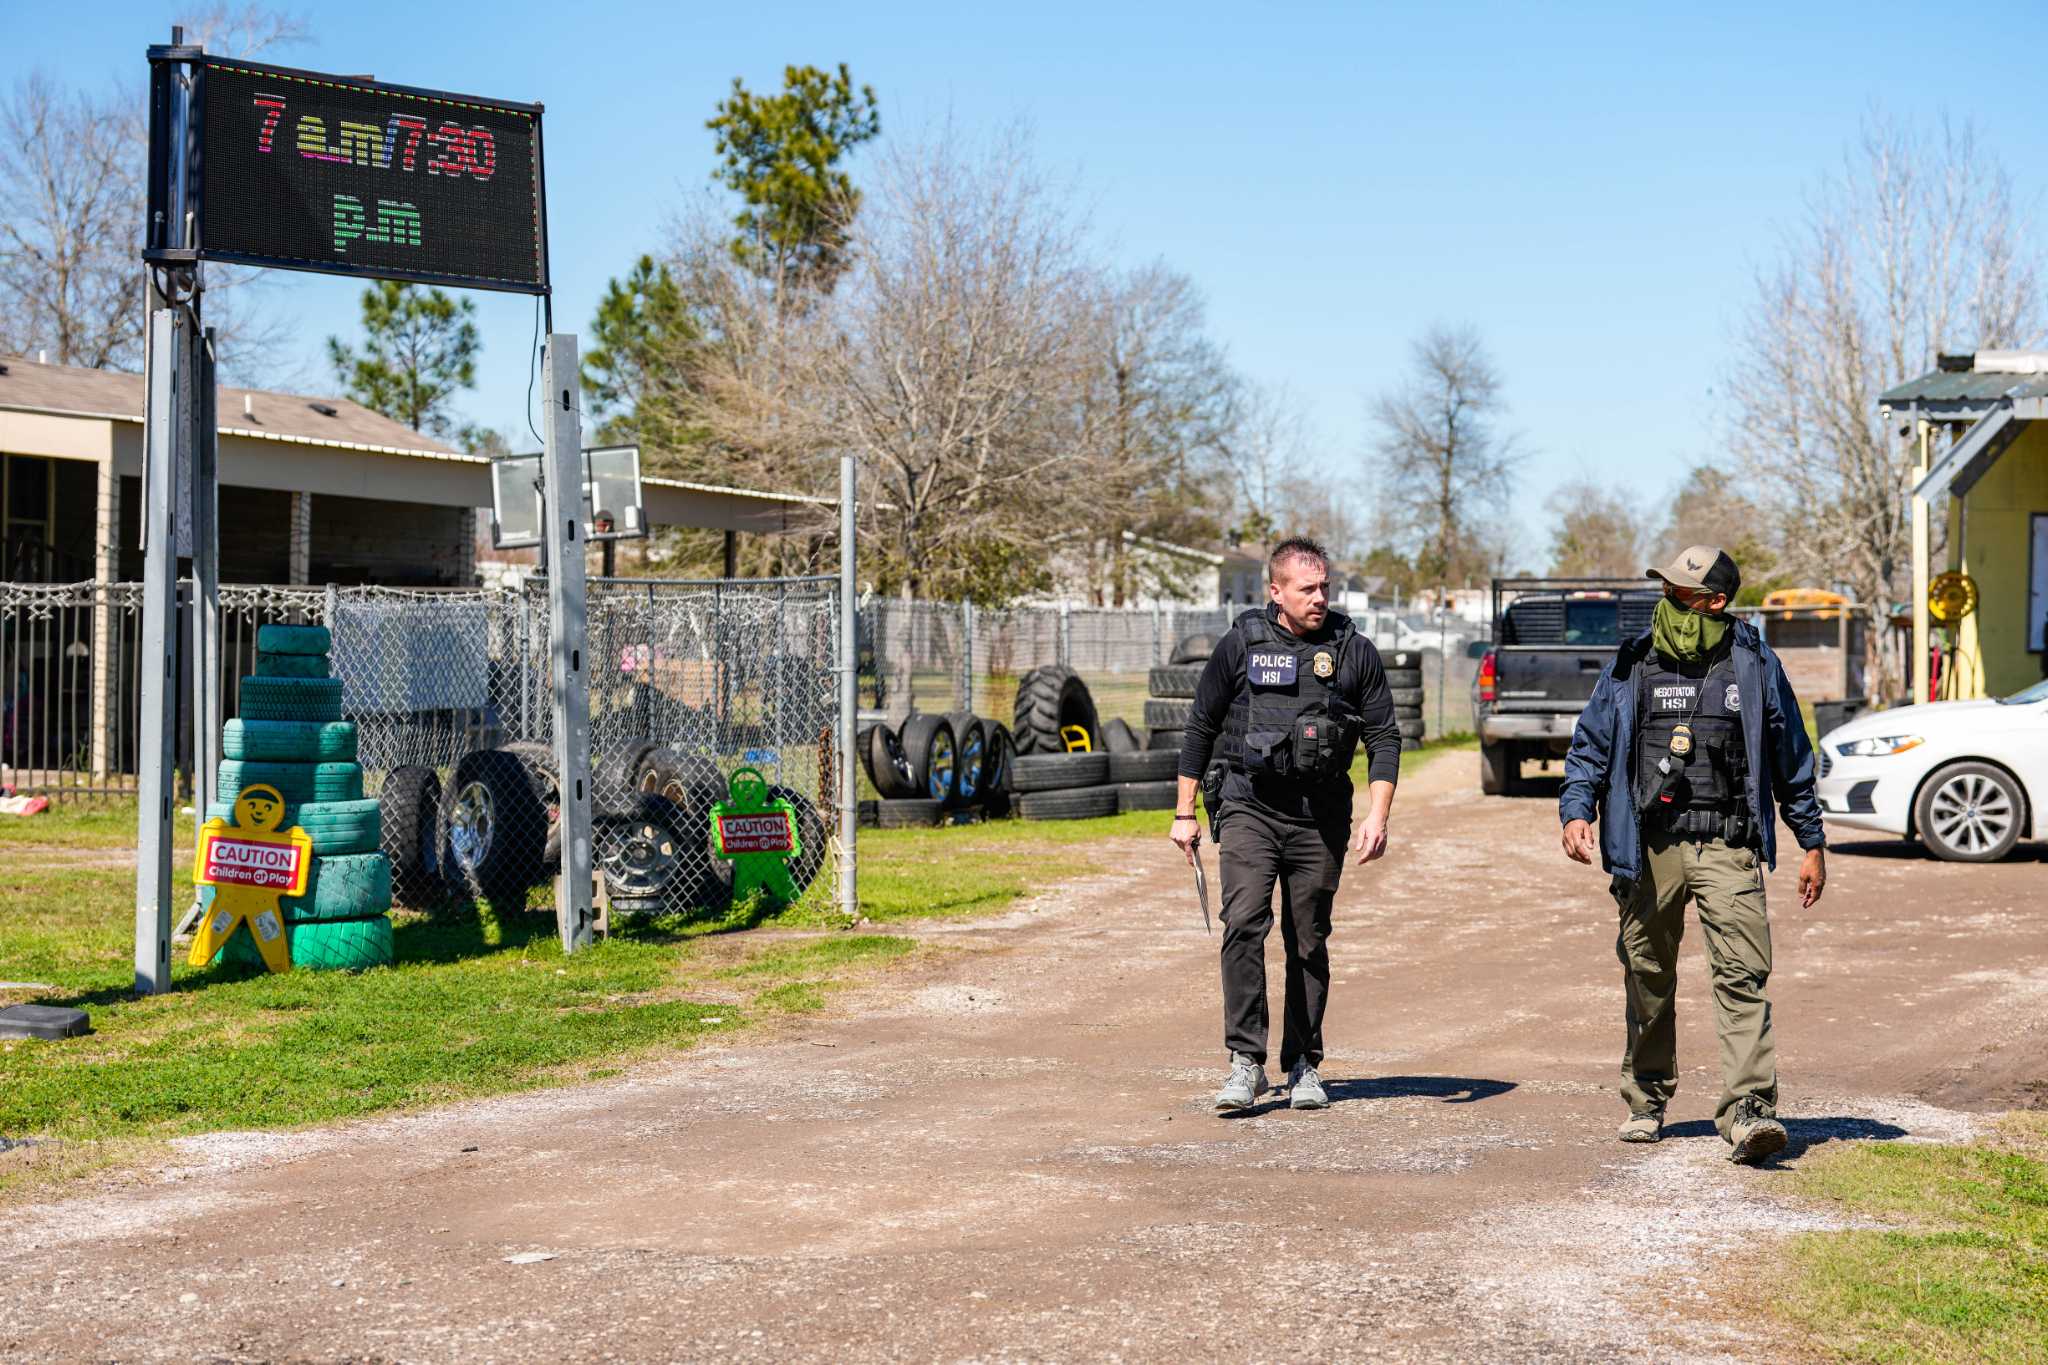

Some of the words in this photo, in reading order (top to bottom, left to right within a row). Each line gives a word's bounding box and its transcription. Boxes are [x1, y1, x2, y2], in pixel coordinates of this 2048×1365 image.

[254, 93, 286, 153] 7
[333, 194, 421, 252] p.m
[1252, 654, 1293, 668] POLICE
[1262, 671, 1281, 684] HSI
[1654, 687, 1695, 697] NEGOTIATOR
[1662, 698, 1687, 709] HSI
[725, 820, 783, 834] CAUTION
[726, 840, 758, 849] Children
[215, 845, 292, 867] CAUTION
[209, 866, 252, 879] Children
[269, 873, 293, 886] Play
